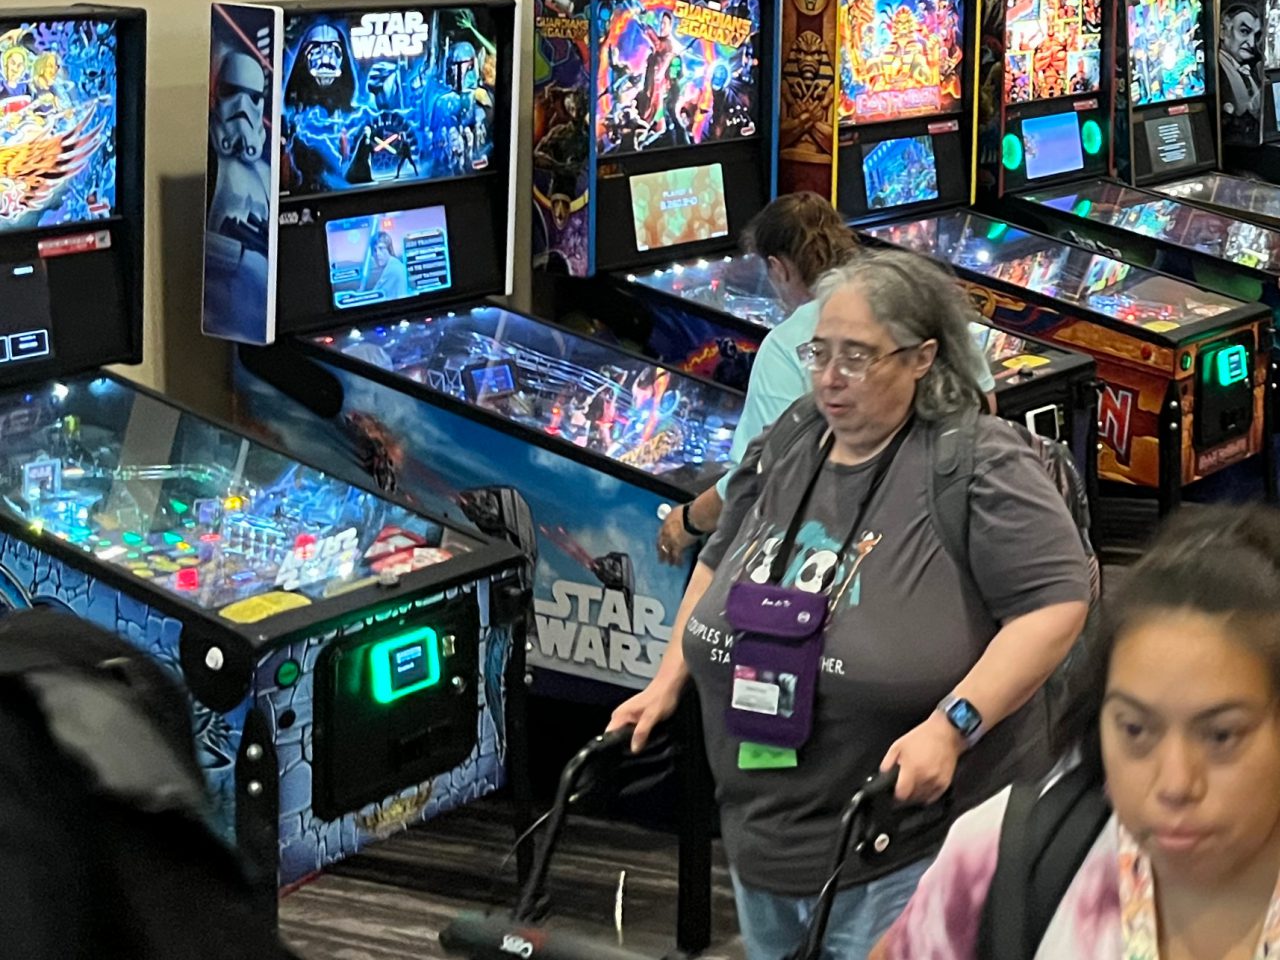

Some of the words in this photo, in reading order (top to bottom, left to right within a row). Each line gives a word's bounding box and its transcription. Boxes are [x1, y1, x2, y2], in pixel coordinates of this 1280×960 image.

[350, 11, 428, 36] STAR
[674, 0, 752, 34] GUARDIANS
[350, 31, 428, 59] WARS
[688, 21, 749, 49] GALAXY
[534, 579, 673, 644] STAR
[534, 615, 669, 680] WARS
[820, 656, 845, 675] HER.
